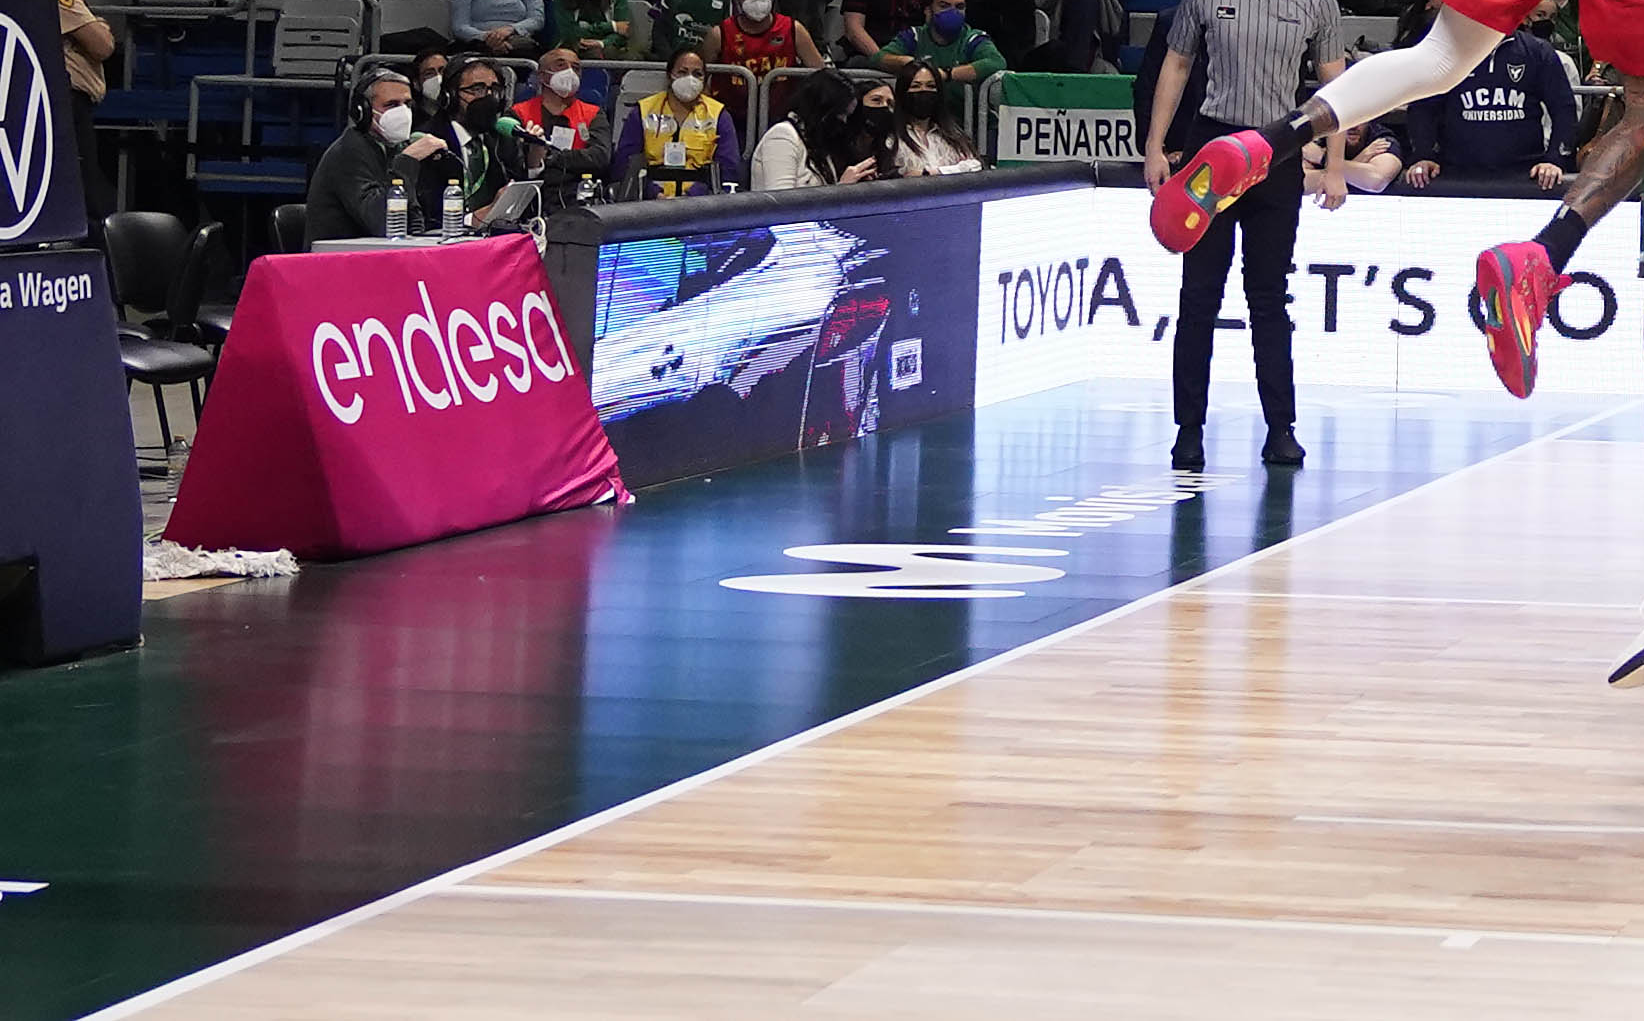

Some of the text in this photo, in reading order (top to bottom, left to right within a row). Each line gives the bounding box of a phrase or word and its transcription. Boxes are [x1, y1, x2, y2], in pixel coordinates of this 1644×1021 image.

[1460, 87, 1526, 109] UCAM
[1462, 109, 1526, 121] UNIVERSIDAD
[18, 272, 92, 313] Wagen
[312, 280, 575, 425] endesa
